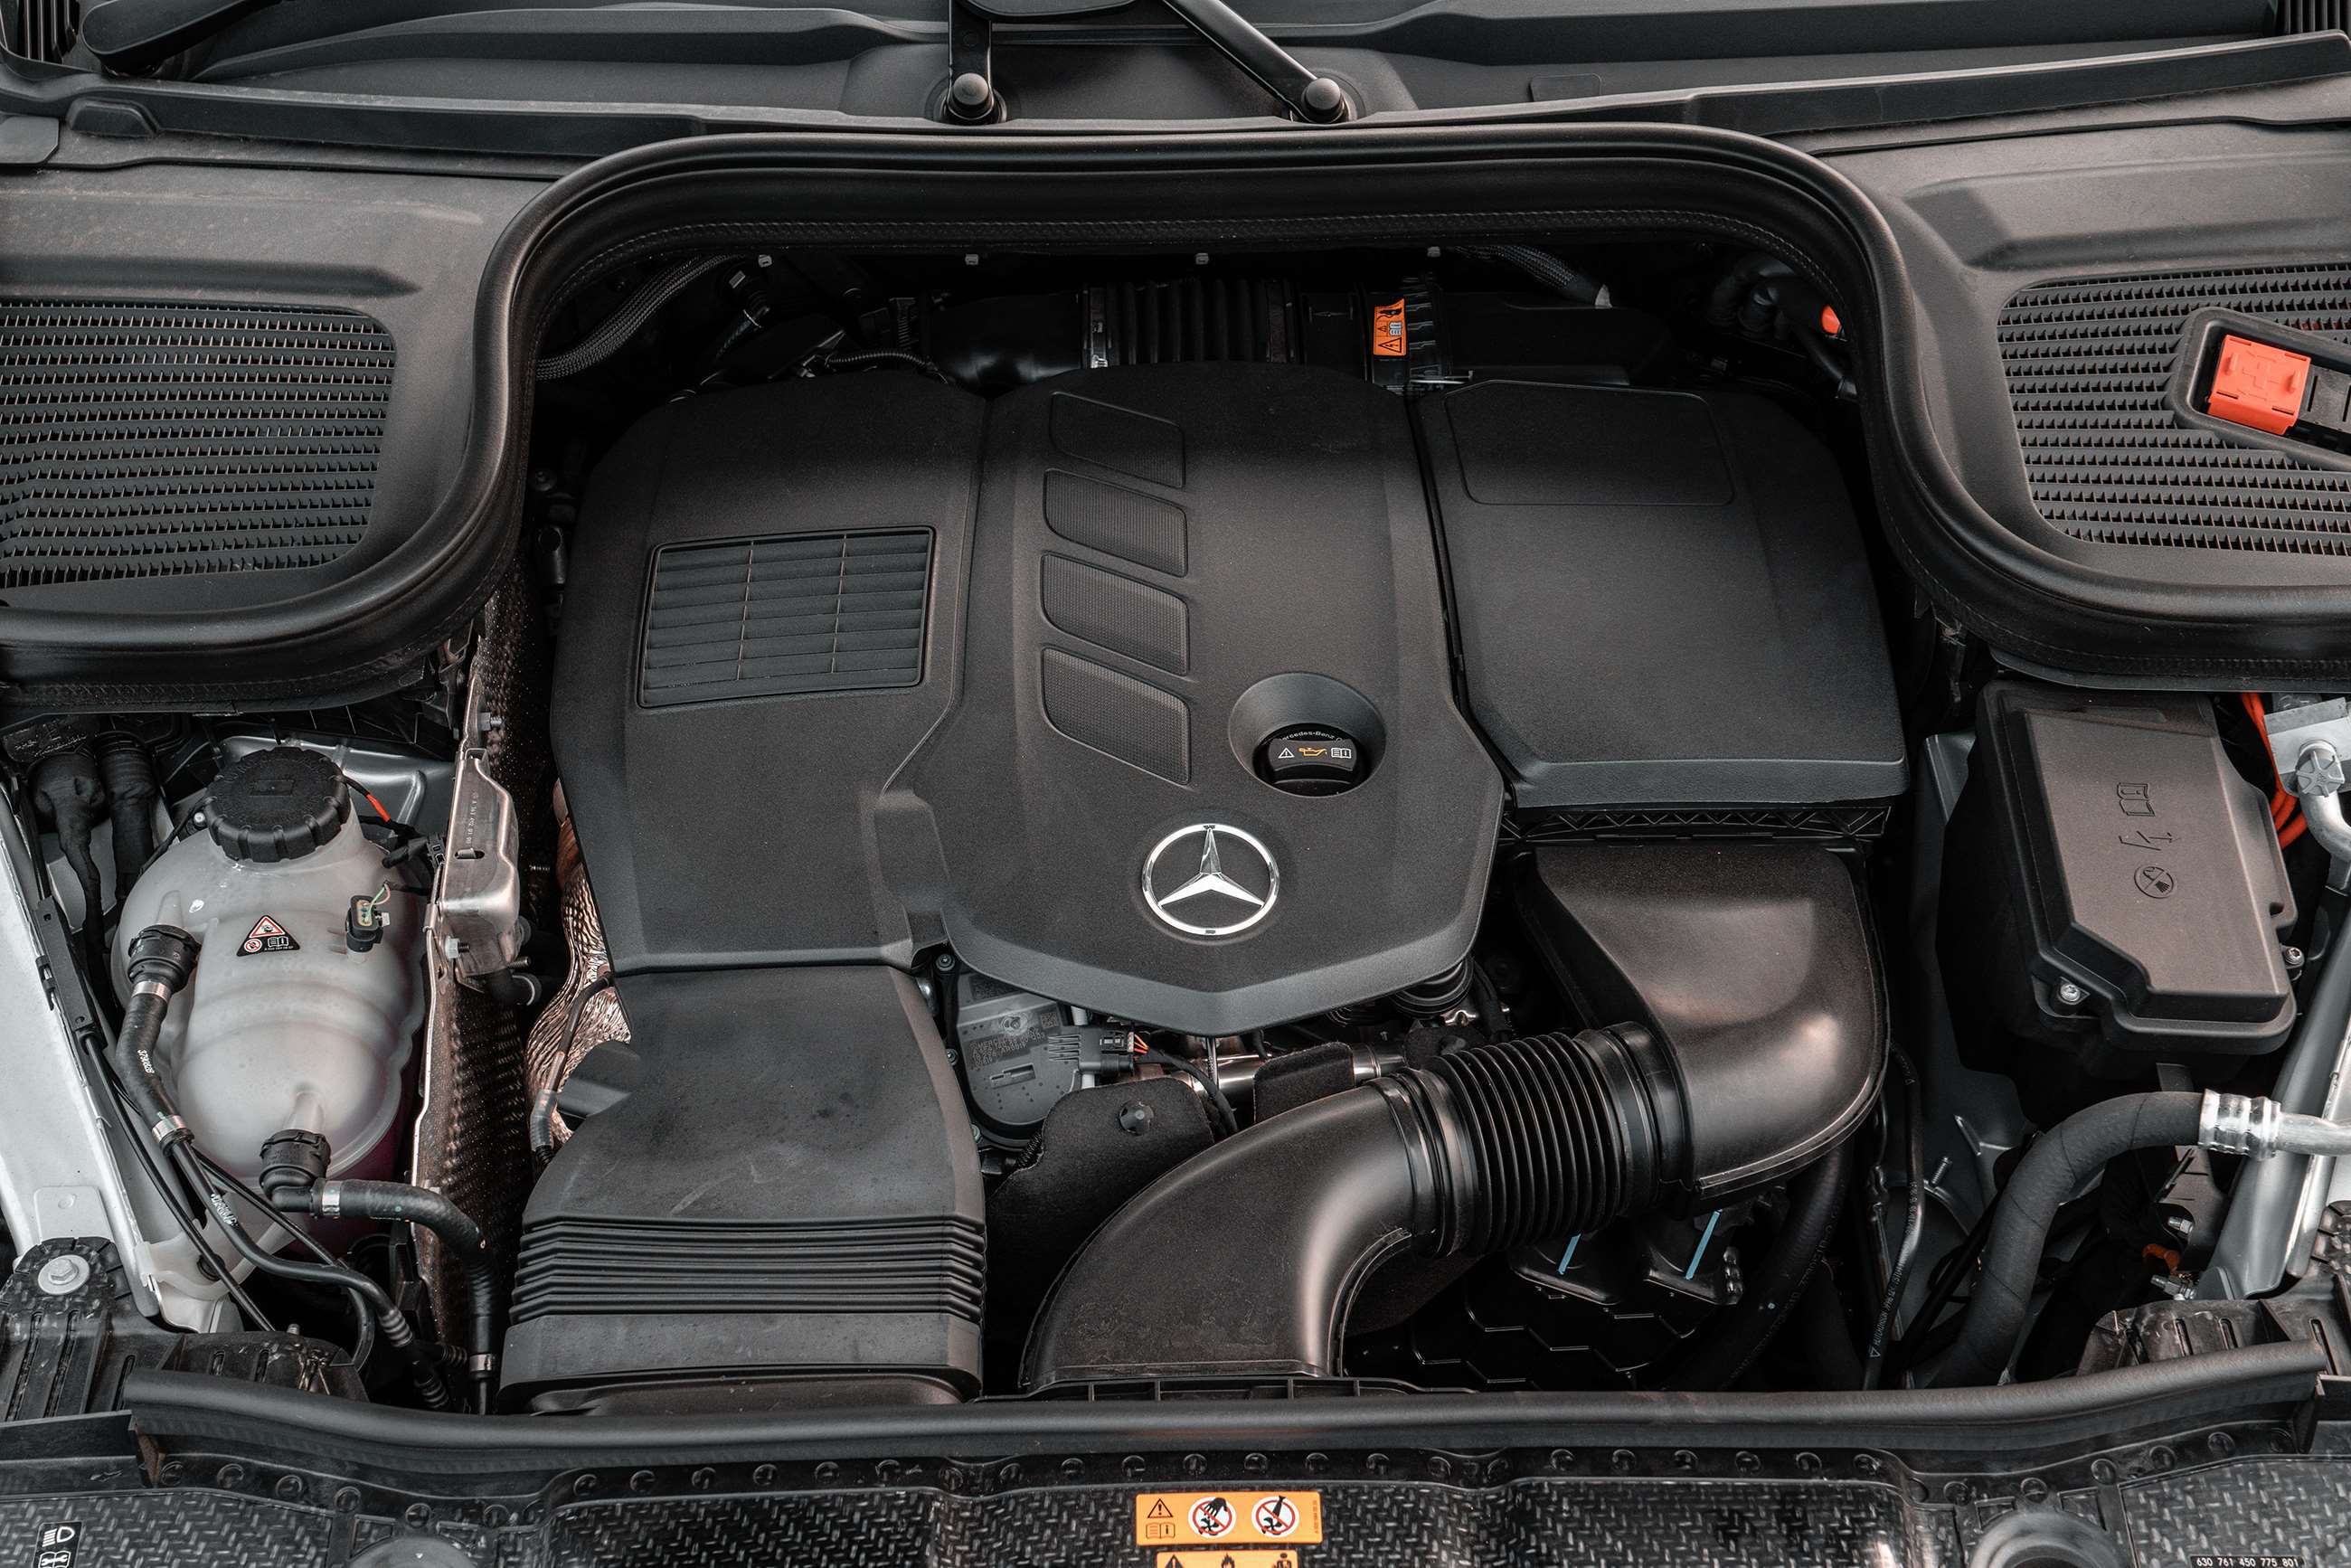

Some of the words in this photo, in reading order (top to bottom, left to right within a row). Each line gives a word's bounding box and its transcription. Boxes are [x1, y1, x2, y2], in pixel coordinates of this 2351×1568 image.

[1282, 731, 1335, 741] ercedes-Benz
[2196, 1557, 2214, 1567] 630
[2217, 1557, 2234, 1567] 761
[2260, 1557, 2278, 1567] 775
[2282, 1557, 2299, 1567] 801
